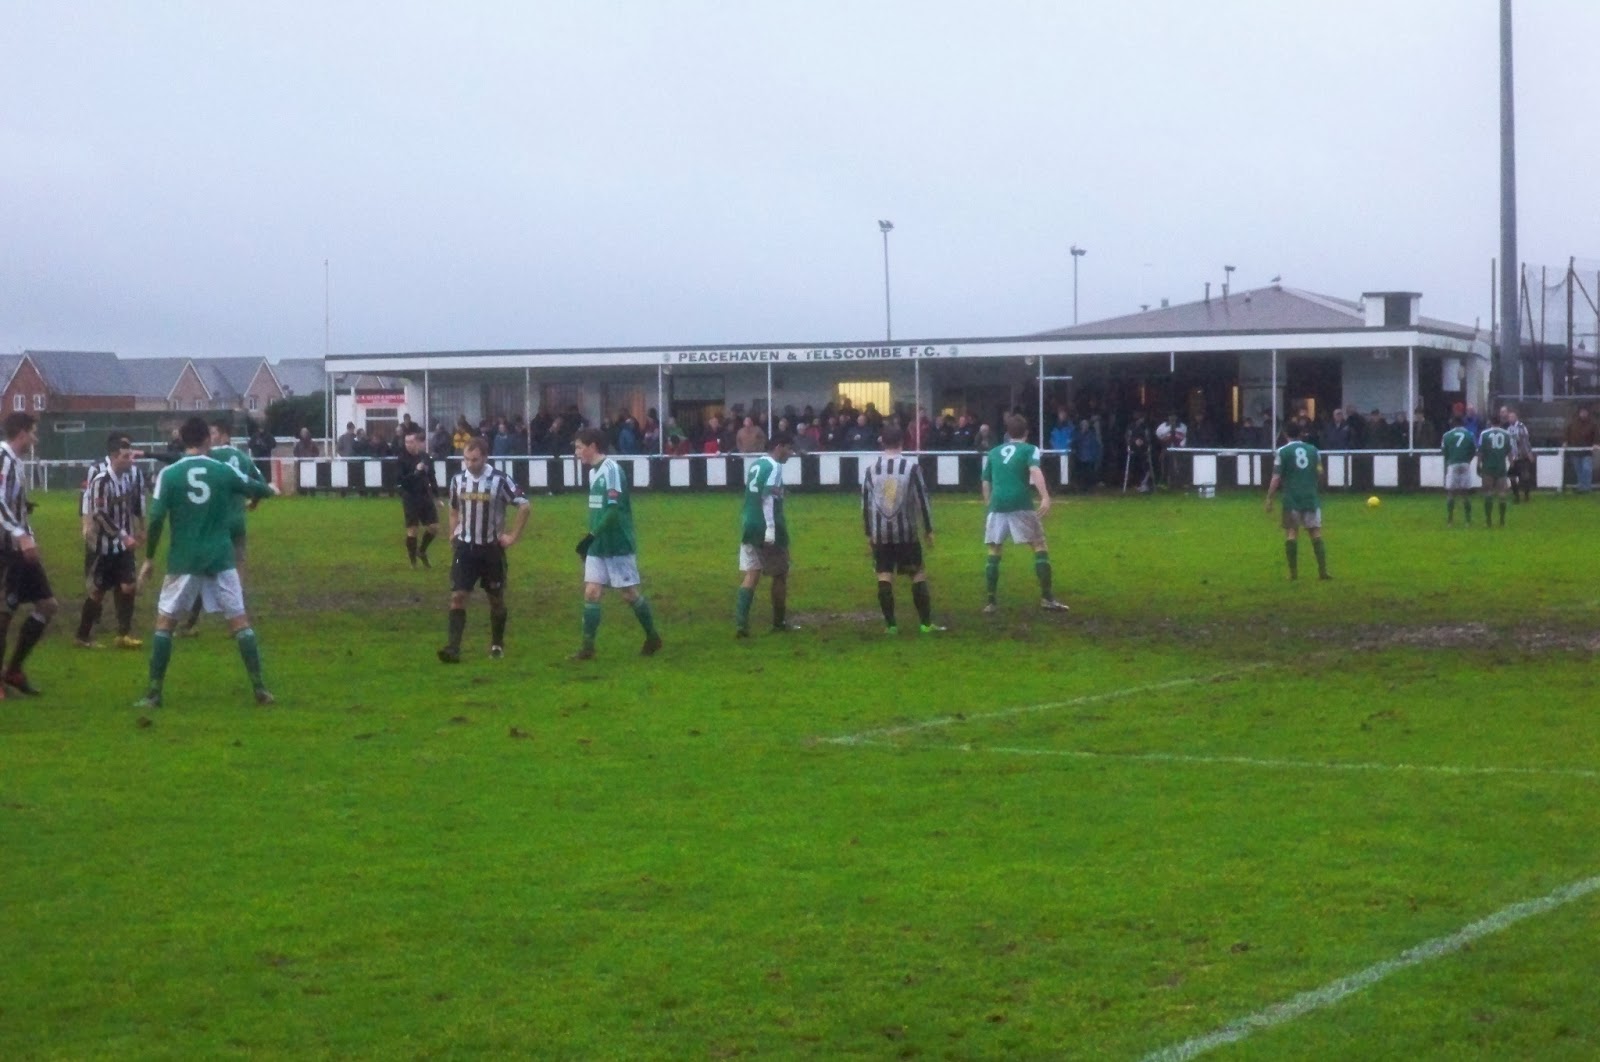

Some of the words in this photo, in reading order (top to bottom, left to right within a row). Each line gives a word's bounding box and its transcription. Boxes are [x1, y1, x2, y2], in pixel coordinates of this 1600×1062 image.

[678, 351, 780, 363] PEACEHAVEN
[787, 351, 798, 361] &
[805, 347, 901, 360] TELSCOMBE
[909, 346, 940, 358] F.C.
[1454, 432, 1465, 448] 7
[1488, 432, 1505, 450] 10
[1000, 444, 1016, 465] 9
[1295, 447, 1309, 470] 8
[187, 467, 211, 505] 5
[749, 464, 761, 493] 2
